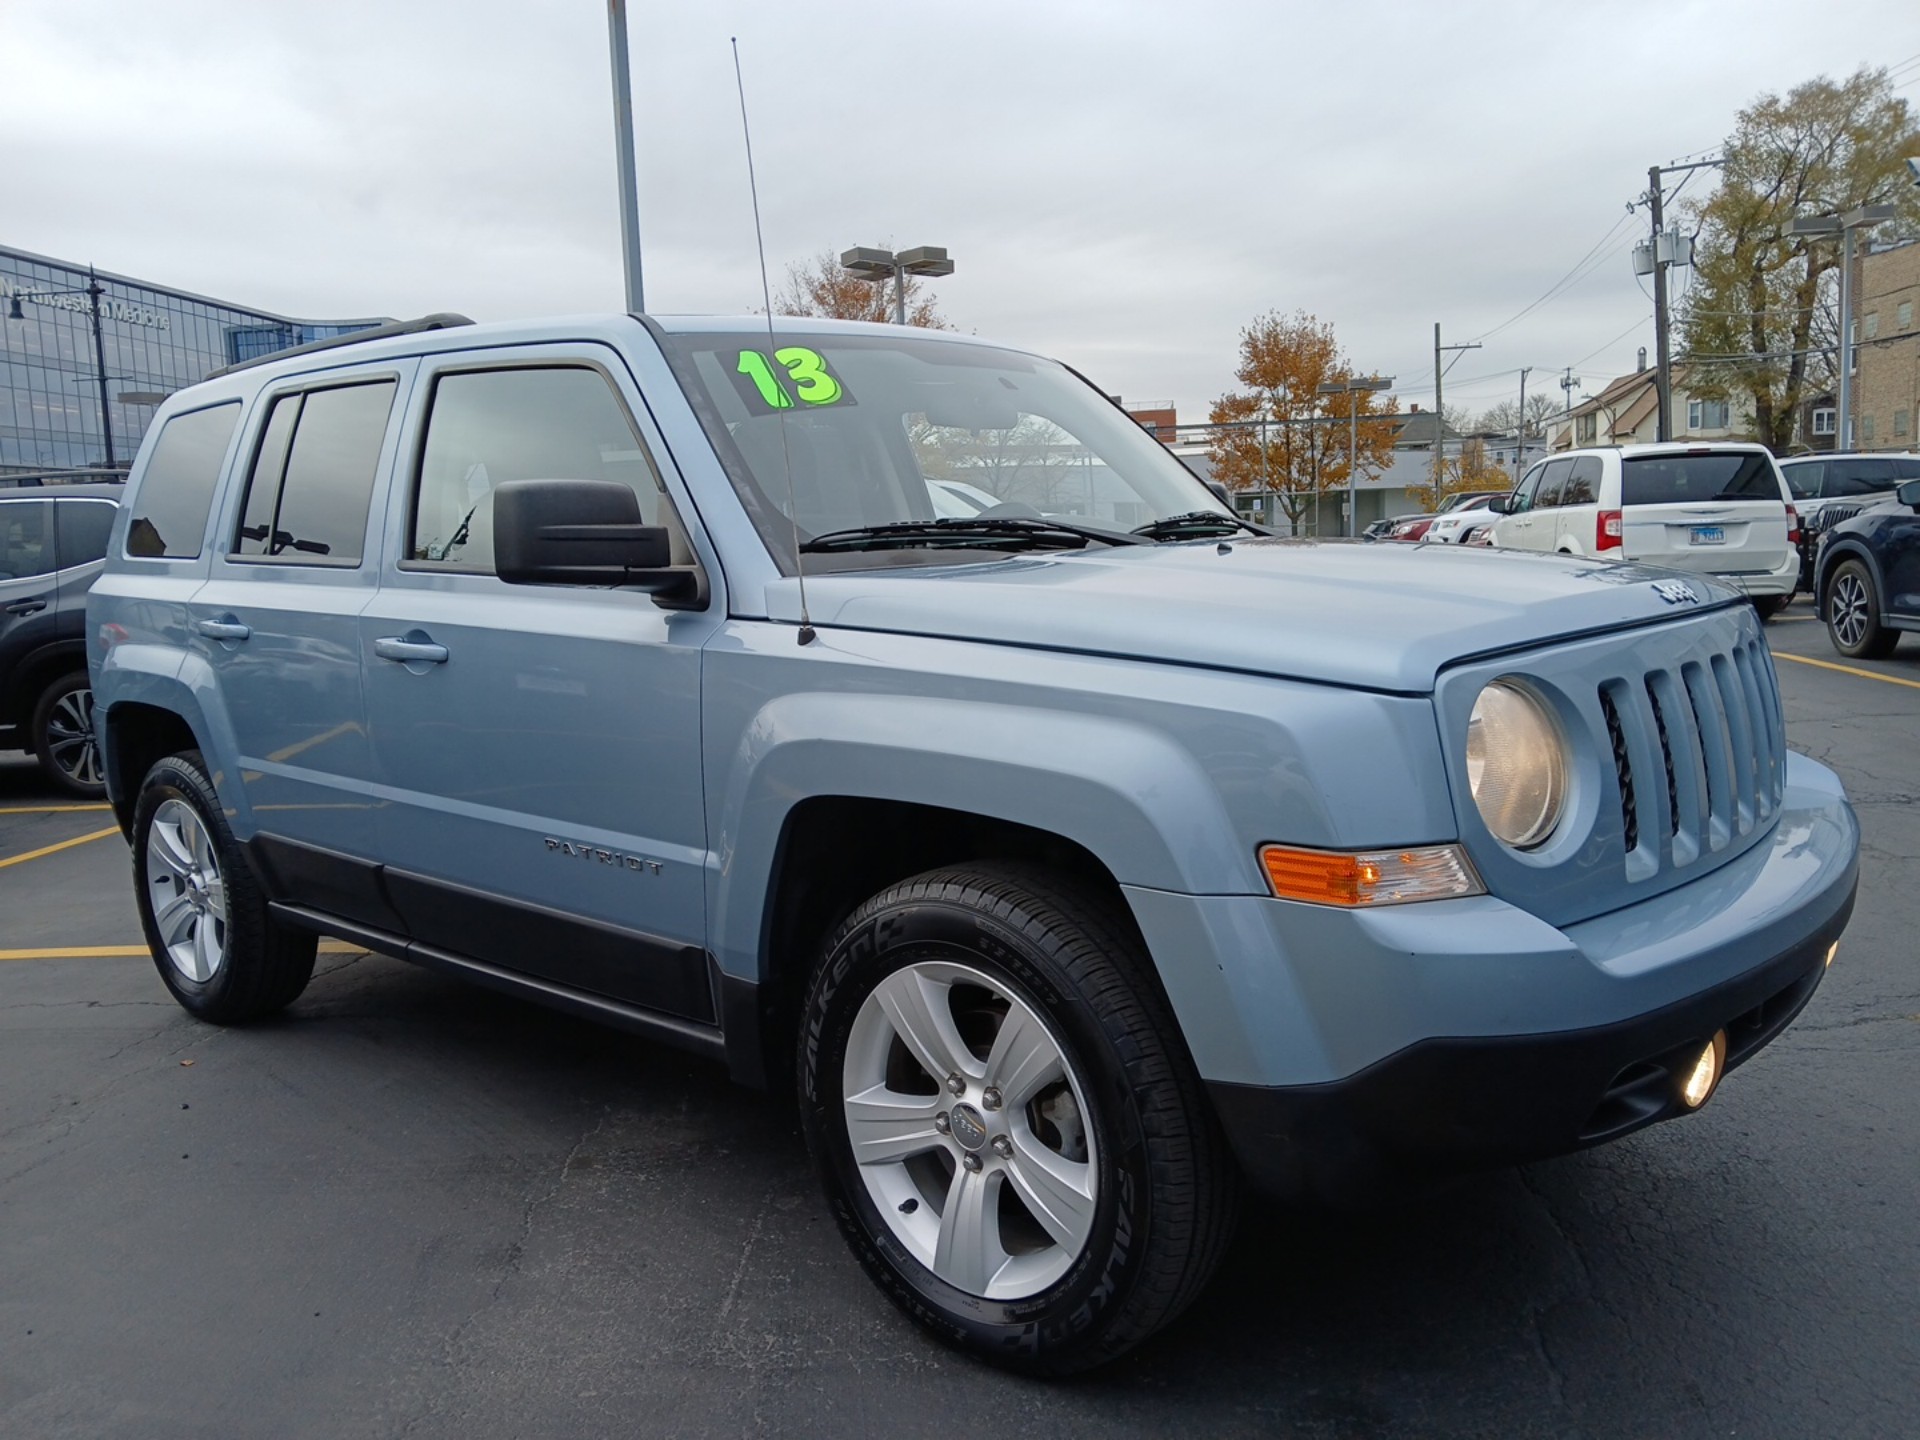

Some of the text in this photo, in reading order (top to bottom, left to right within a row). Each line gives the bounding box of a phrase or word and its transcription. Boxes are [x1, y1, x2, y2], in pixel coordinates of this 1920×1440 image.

[0, 276, 171, 330] Northwesten Medicine
[737, 347, 843, 408] 13
[544, 836, 664, 876] PATRIOT
